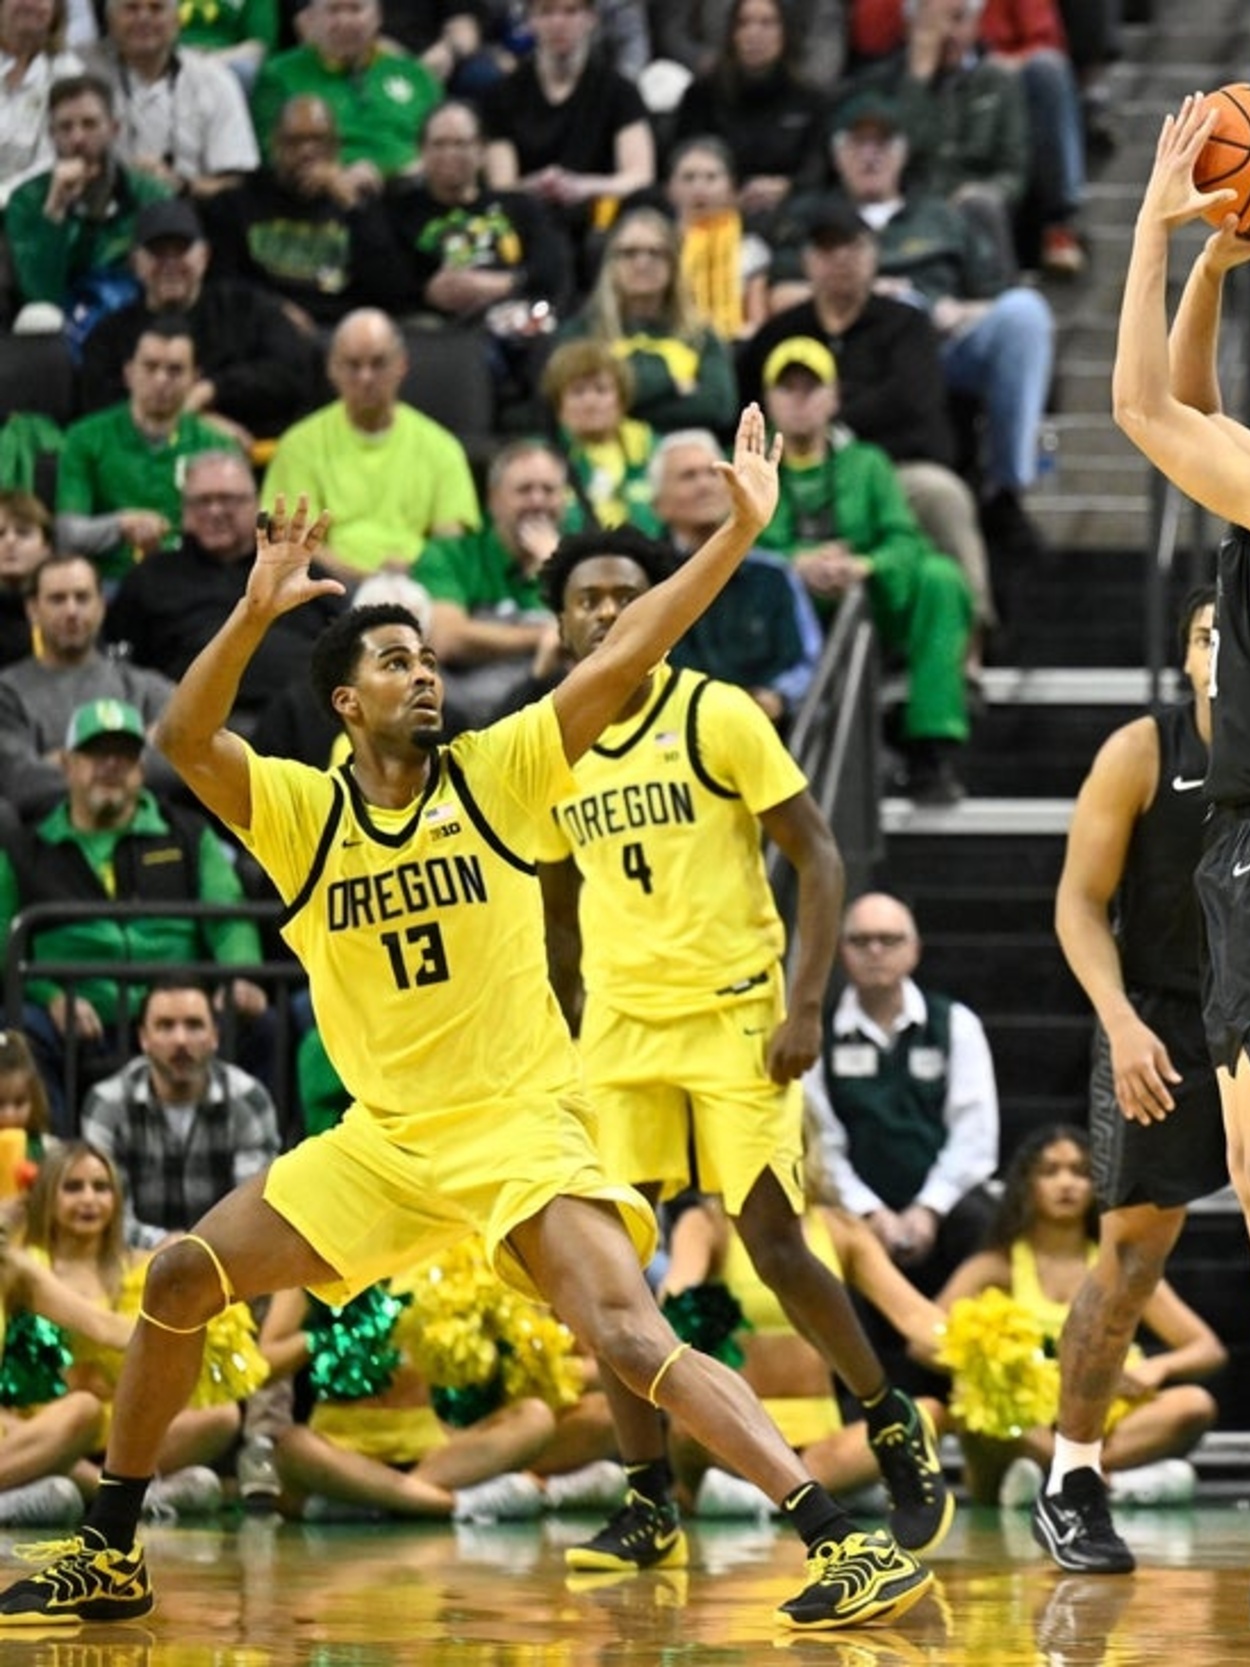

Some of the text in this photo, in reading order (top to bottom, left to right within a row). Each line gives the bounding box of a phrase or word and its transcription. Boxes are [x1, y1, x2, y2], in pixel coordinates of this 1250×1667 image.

[564, 782, 695, 847] OREGON
[328, 855, 488, 932] OREGON
[622, 842, 653, 894] 4
[380, 921, 450, 991] 13
